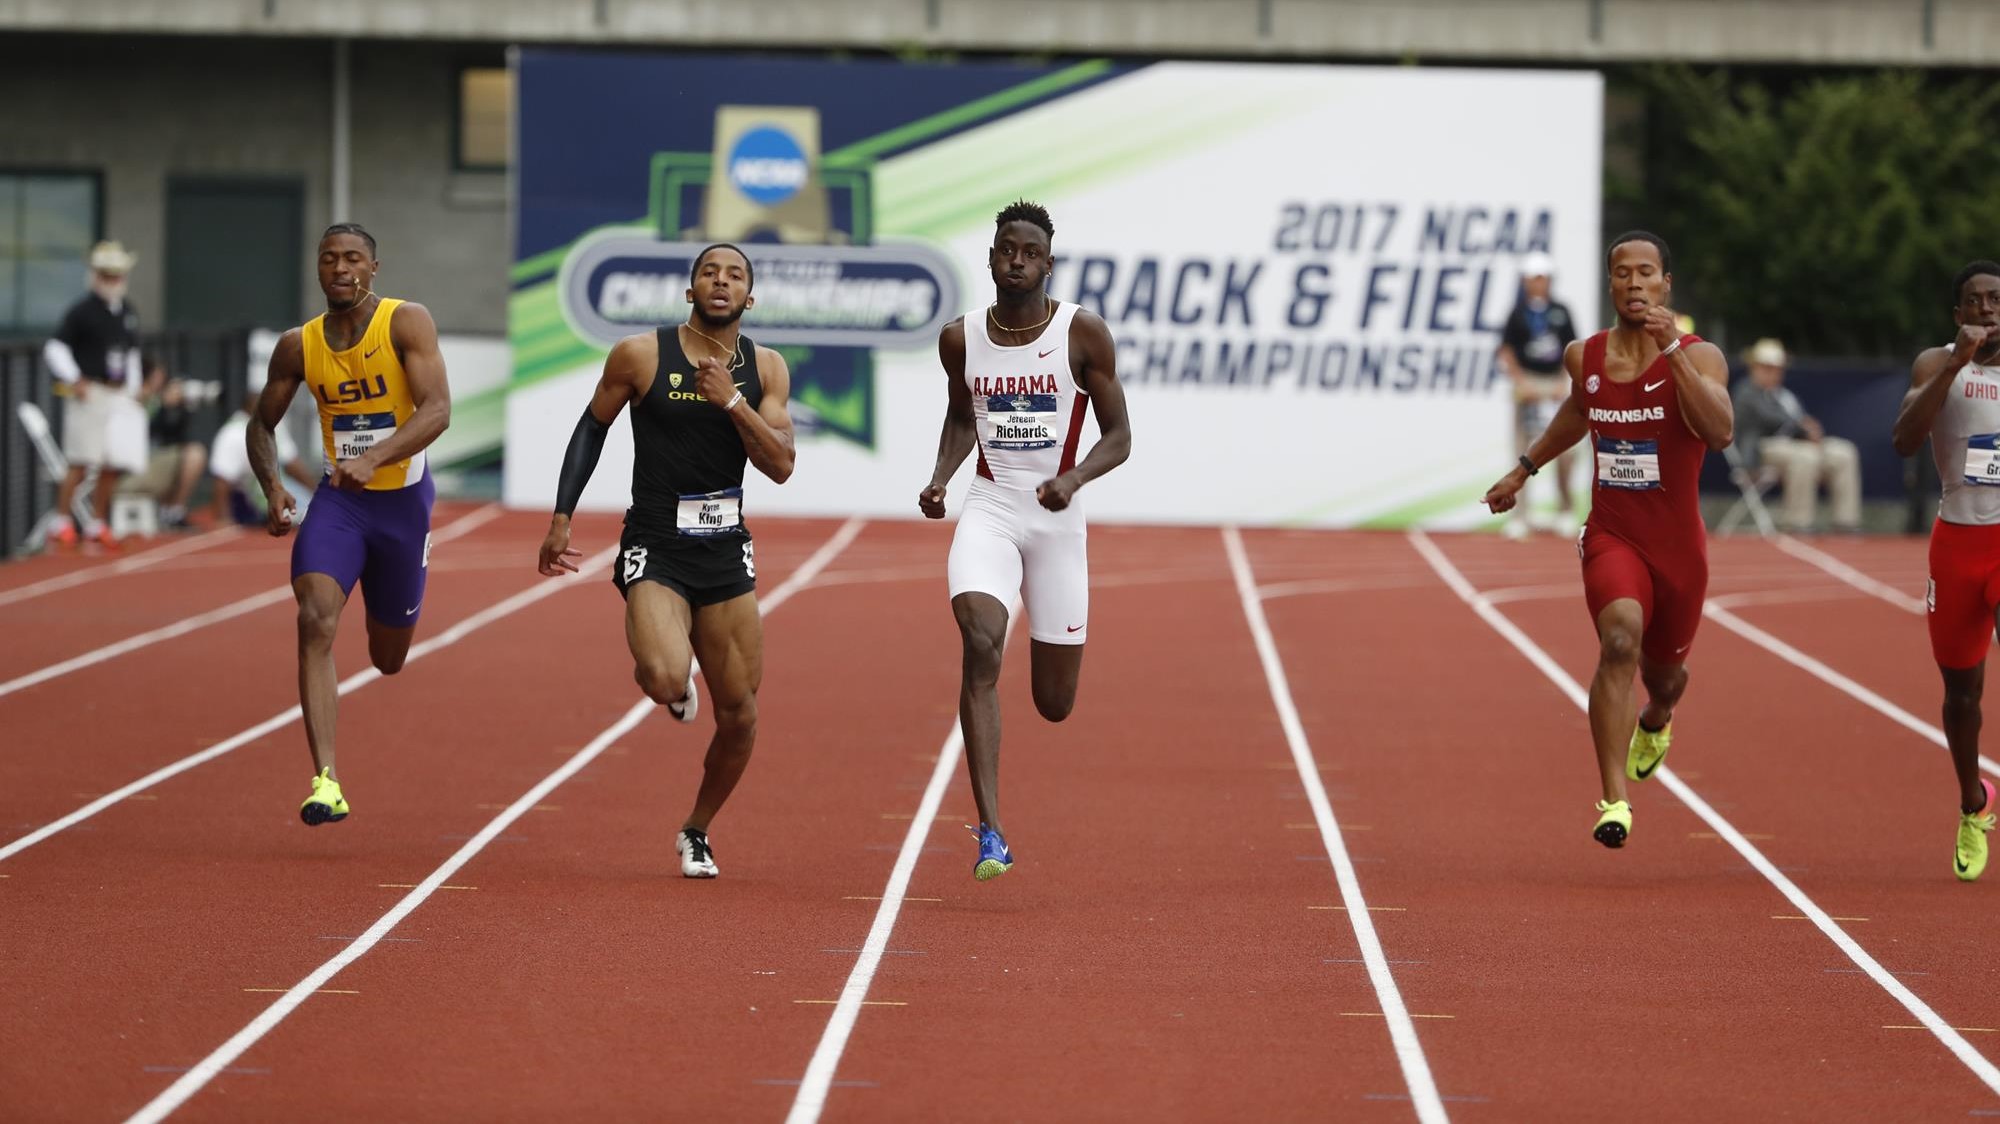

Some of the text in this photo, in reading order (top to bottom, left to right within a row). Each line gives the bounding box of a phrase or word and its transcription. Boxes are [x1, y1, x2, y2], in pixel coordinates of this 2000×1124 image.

[1273, 204, 1552, 256] 2017 NCAA
[1288, 264, 1331, 328] &
[1359, 266, 1524, 334] FIEL
[318, 375, 388, 404] LSU
[974, 374, 1058, 397] ALABAMA
[1965, 382, 1998, 399] OHIO
[668, 391, 708, 402] ORE
[1588, 406, 1665, 423] ARKANSAS
[996, 425, 1048, 439] Richards
[1610, 466, 1644, 479] Cotton
[1987, 463, 2000, 476] Gr
[698, 511, 722, 526] King
